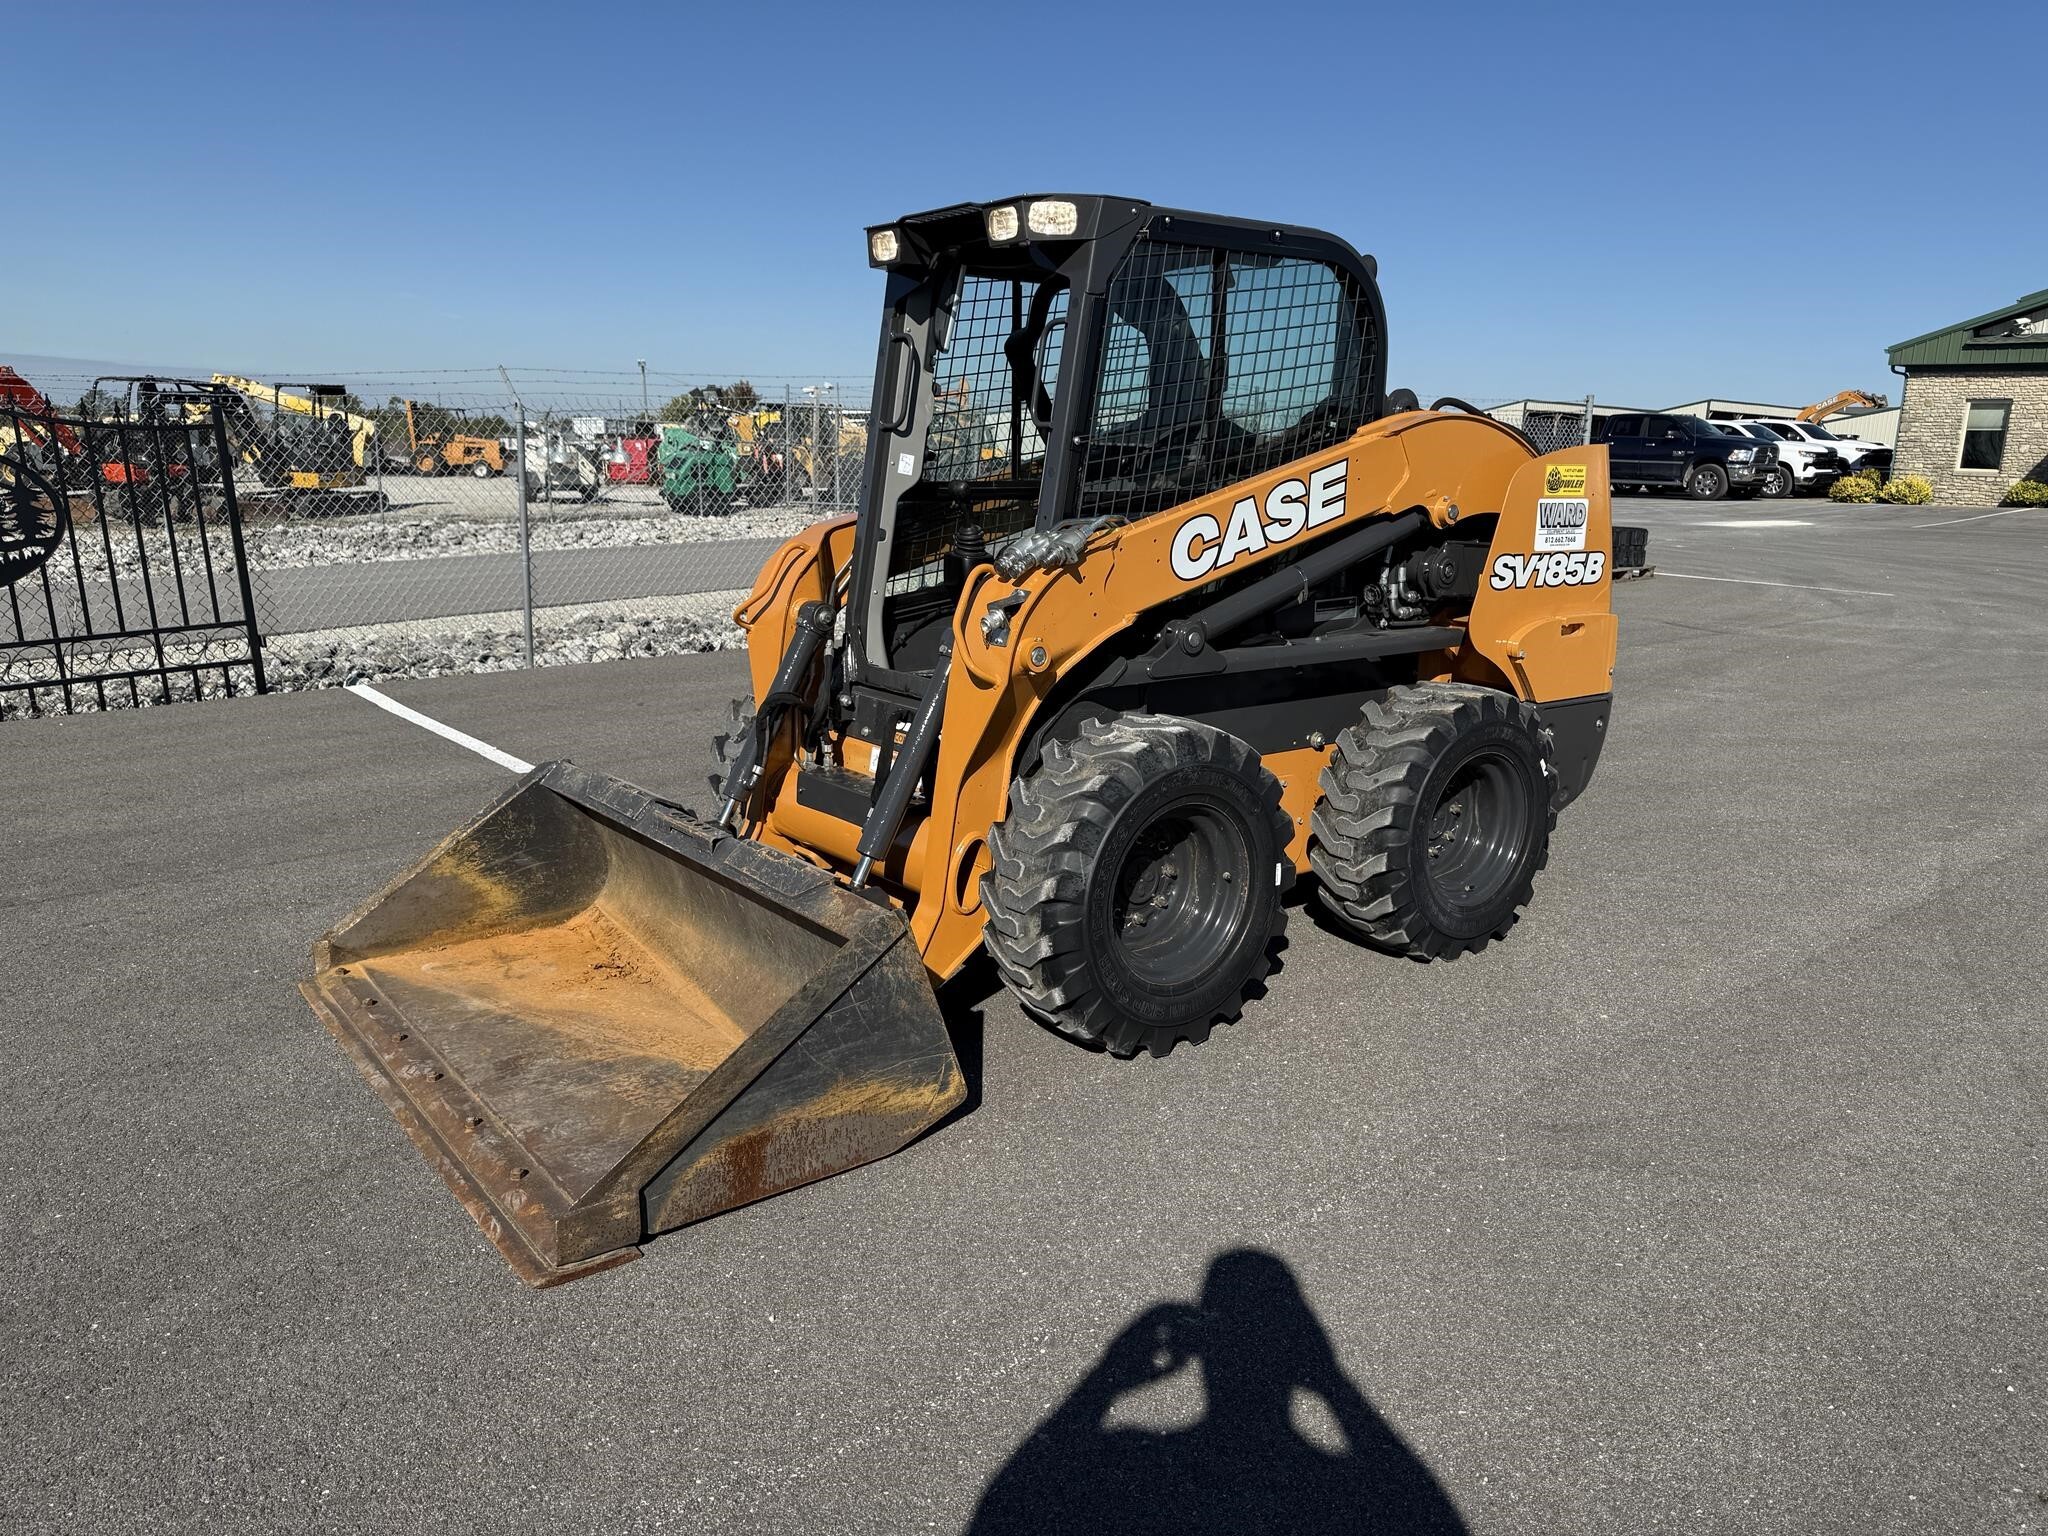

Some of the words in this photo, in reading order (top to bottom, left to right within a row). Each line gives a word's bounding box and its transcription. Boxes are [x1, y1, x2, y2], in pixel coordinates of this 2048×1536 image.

[1815, 396, 1839, 410] CASE
[1170, 457, 1349, 582] CASE
[1539, 502, 1587, 529] WARD
[1489, 551, 1606, 591] SV185B
